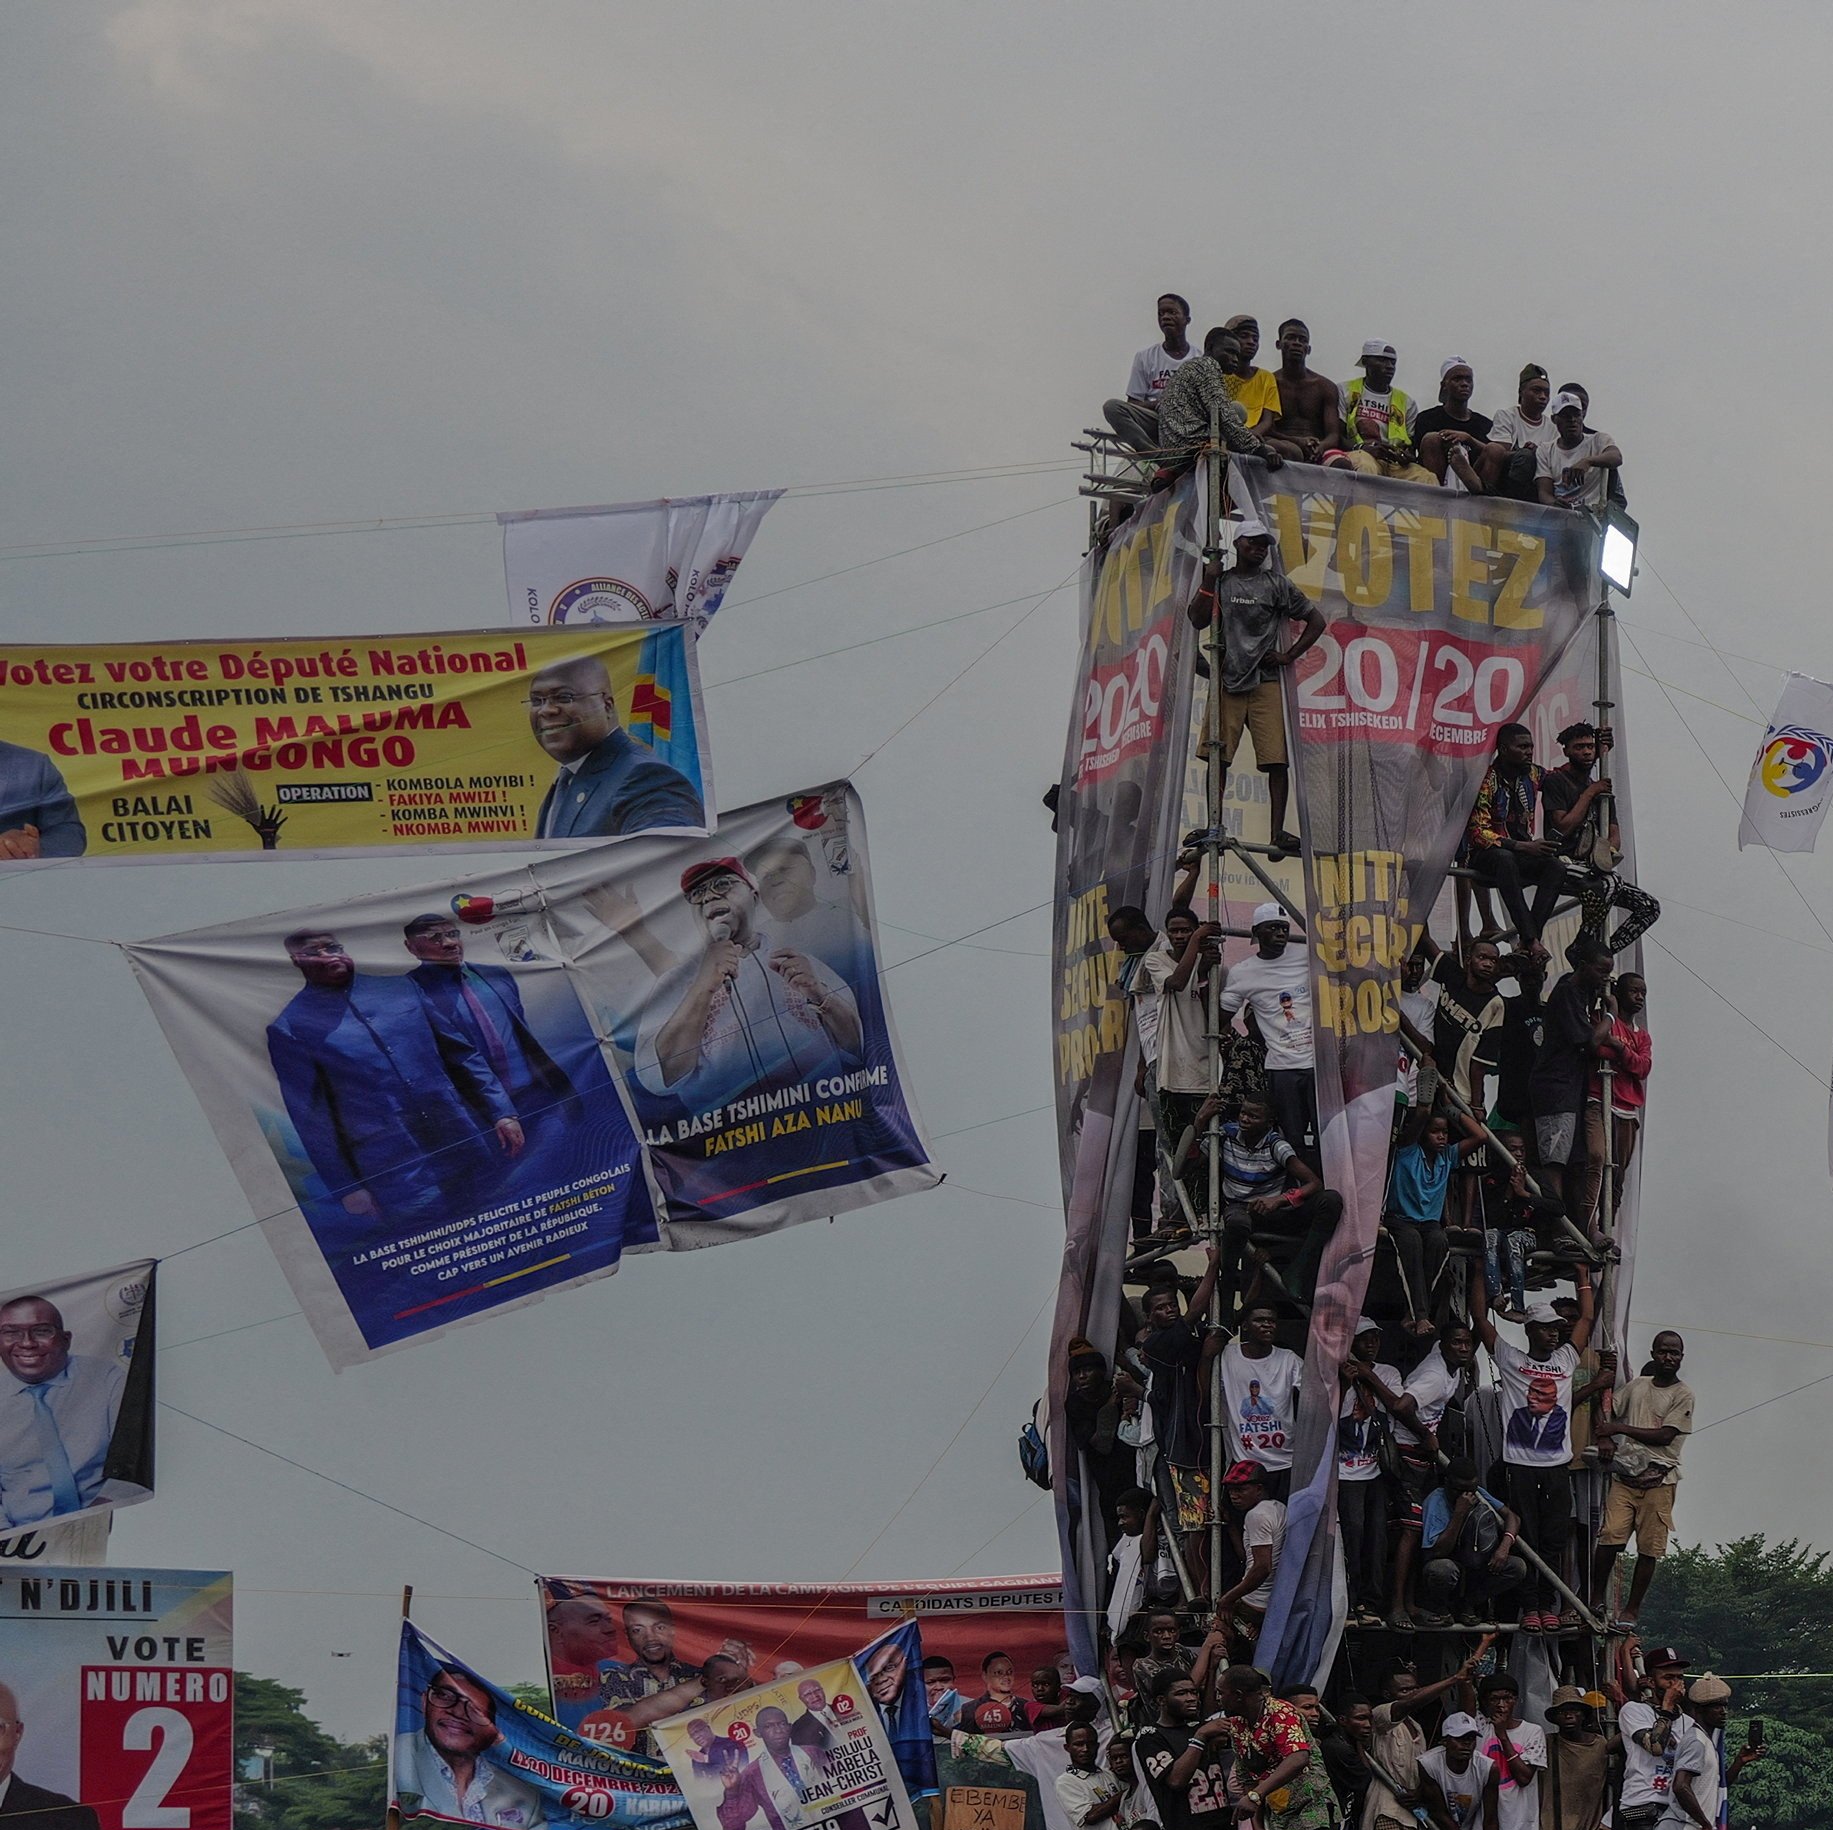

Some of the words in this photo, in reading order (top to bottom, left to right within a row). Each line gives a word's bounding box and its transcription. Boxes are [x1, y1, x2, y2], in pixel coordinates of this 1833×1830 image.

[1270, 494, 1547, 629] VOTEZ
[1231, 596, 1255, 605] Urban
[104, 656, 208, 682] votre
[219, 649, 358, 686] Député
[369, 643, 528, 676] National
[77, 687, 287, 710] CIRCONSCRIPTION
[295, 686, 322, 703] DE
[329, 683, 434, 702] TSHANGU
[1294, 635, 1525, 731] 20/20
[49, 714, 237, 756] Claude
[255, 701, 471, 745] MALUMA
[1330, 712, 1402, 729] TSHISEKEDI
[122, 735, 416, 781] MUNGONGO
[279, 784, 371, 802] OPERATION
[387, 777, 462, 791] KOMBOLA
[469, 775, 525, 790] MOYIBI
[112, 795, 193, 817] BALAI
[389, 793, 443, 806] FAKIYA
[449, 791, 497, 805] MWIZI
[102, 819, 212, 843] CITOYEN
[647, 1125, 674, 1147] LA
[677, 1110, 723, 1141] BASE
[726, 1083, 810, 1124] TSHIMINI
[704, 1122, 767, 1158] FATSHI
[771, 1112, 812, 1139] AZA
[816, 1099, 862, 1127] NANU
[353, 1254, 368, 1265] LA
[370, 1244, 397, 1260] BASE
[398, 1217, 476, 1250] TSHIMINI/UDPS
[478, 1203, 520, 1224] FELICITE
[522, 1198, 534, 1209] LE
[535, 1185, 570, 1204] PEUPLE
[572, 1163, 631, 1190] CONGOLAIS
[21, 1579, 152, 1611] N'DJILI
[106, 1636, 206, 1662] VOTE
[86, 1671, 229, 1703] NUMERO
[583, 1722, 626, 1743] 726
[847, 1727, 867, 1740] PROF
[825, 1736, 872, 1763] NSILULU
[121, 1706, 194, 1830] 2
[823, 1749, 880, 1780] MABELA
[1146, 1750, 1174, 1779] 22
[800, 1762, 885, 1805] JEAN-CHRIST
[950, 1789, 1026, 1813] EBEMBE
[973, 1807, 995, 1827] YA
